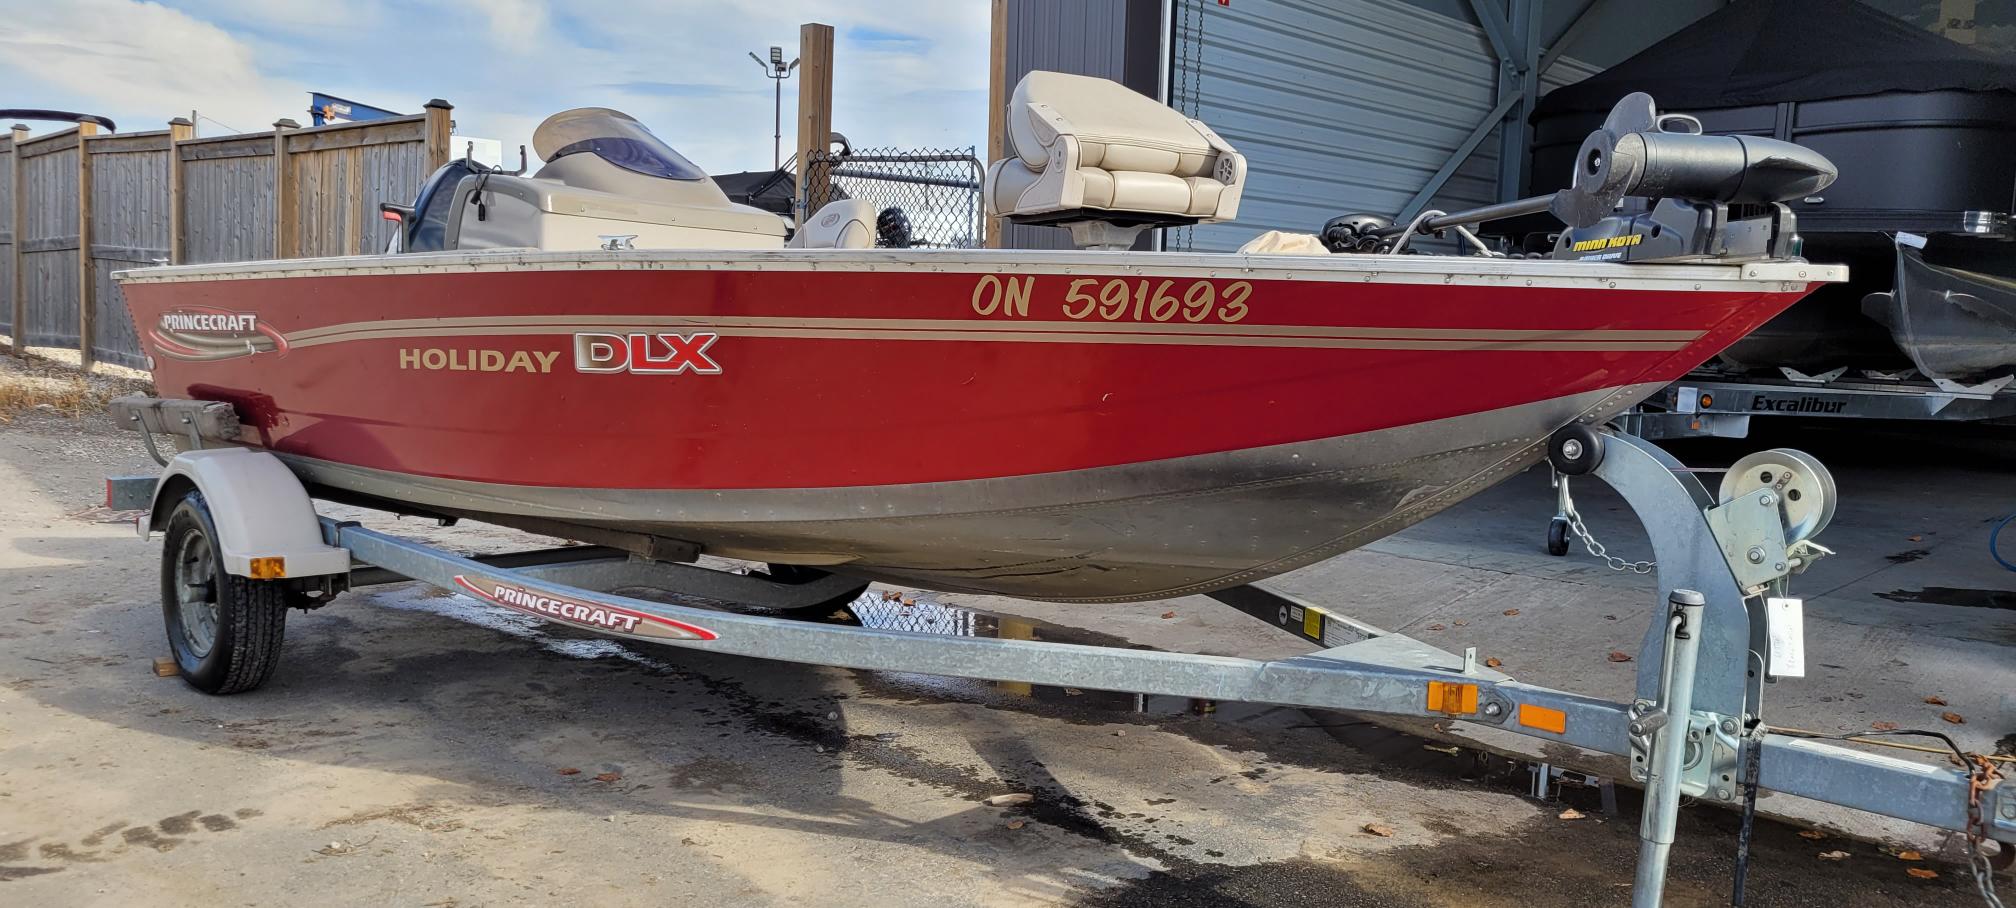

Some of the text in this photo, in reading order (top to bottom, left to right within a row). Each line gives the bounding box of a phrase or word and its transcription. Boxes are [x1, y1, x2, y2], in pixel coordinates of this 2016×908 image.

[1572, 234, 1643, 252] MINN KOTA
[972, 274, 1253, 322] ON 591693
[162, 314, 257, 331] PRINCECRAFT
[399, 332, 723, 375] HOLIDAY DLX
[1751, 395, 1848, 413] Excalibur
[494, 585, 642, 632] PRINCECRAFT
